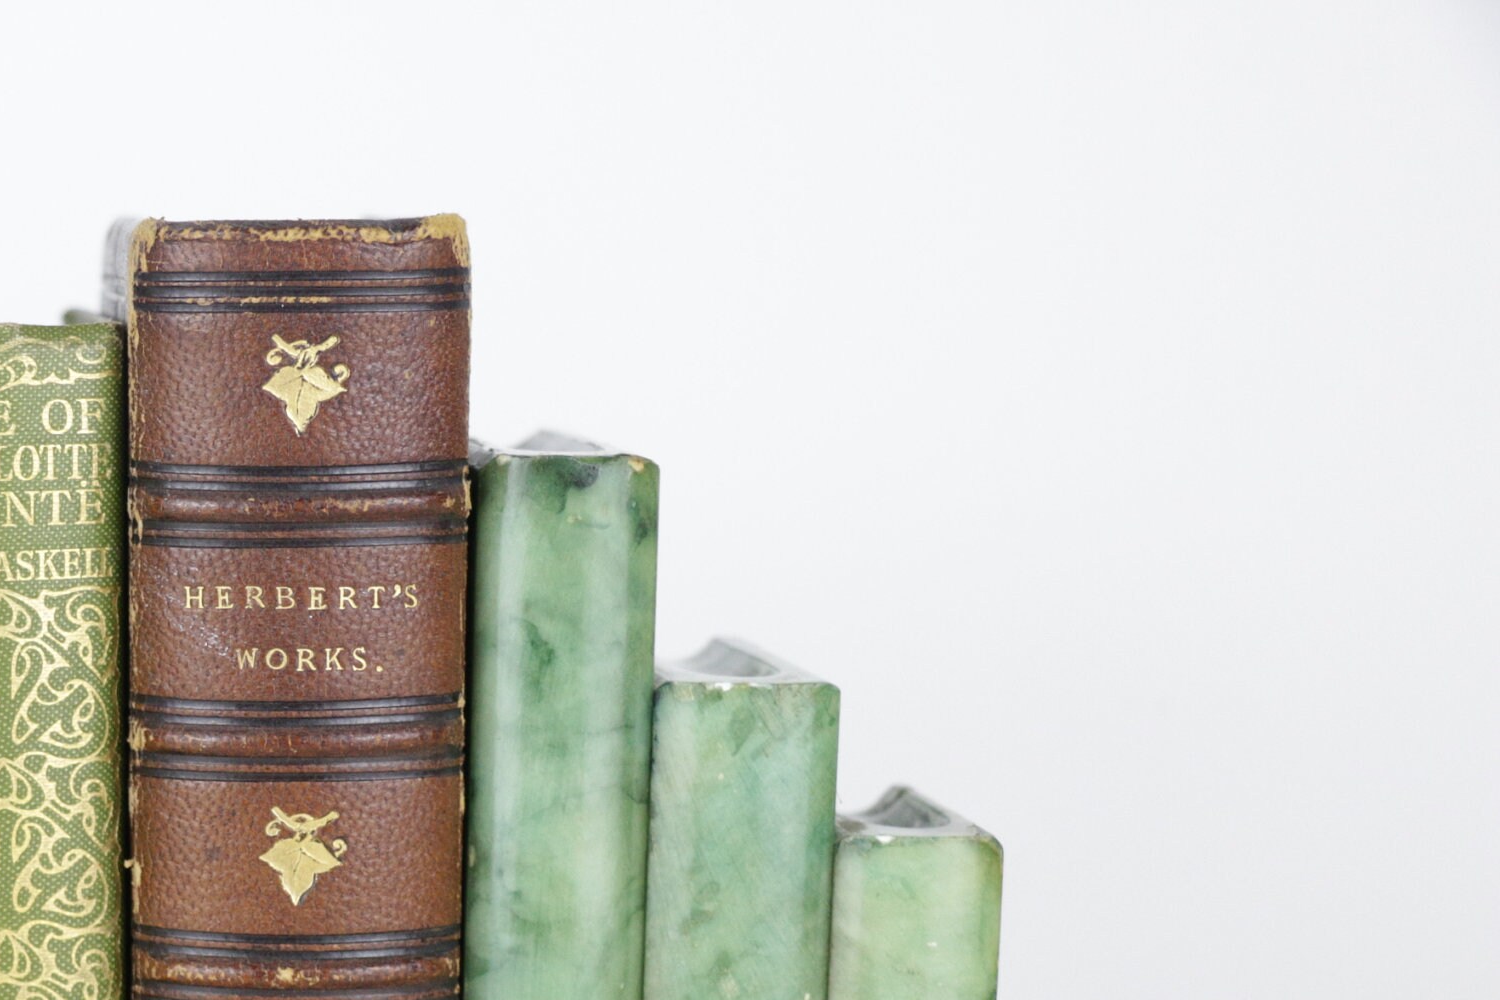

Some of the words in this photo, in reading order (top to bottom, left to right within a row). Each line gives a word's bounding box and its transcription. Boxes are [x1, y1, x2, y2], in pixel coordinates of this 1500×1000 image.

[41, 397, 106, 436] OF
[184, 584, 420, 612] HERBERT'S
[236, 646, 385, 674] WORKS.
